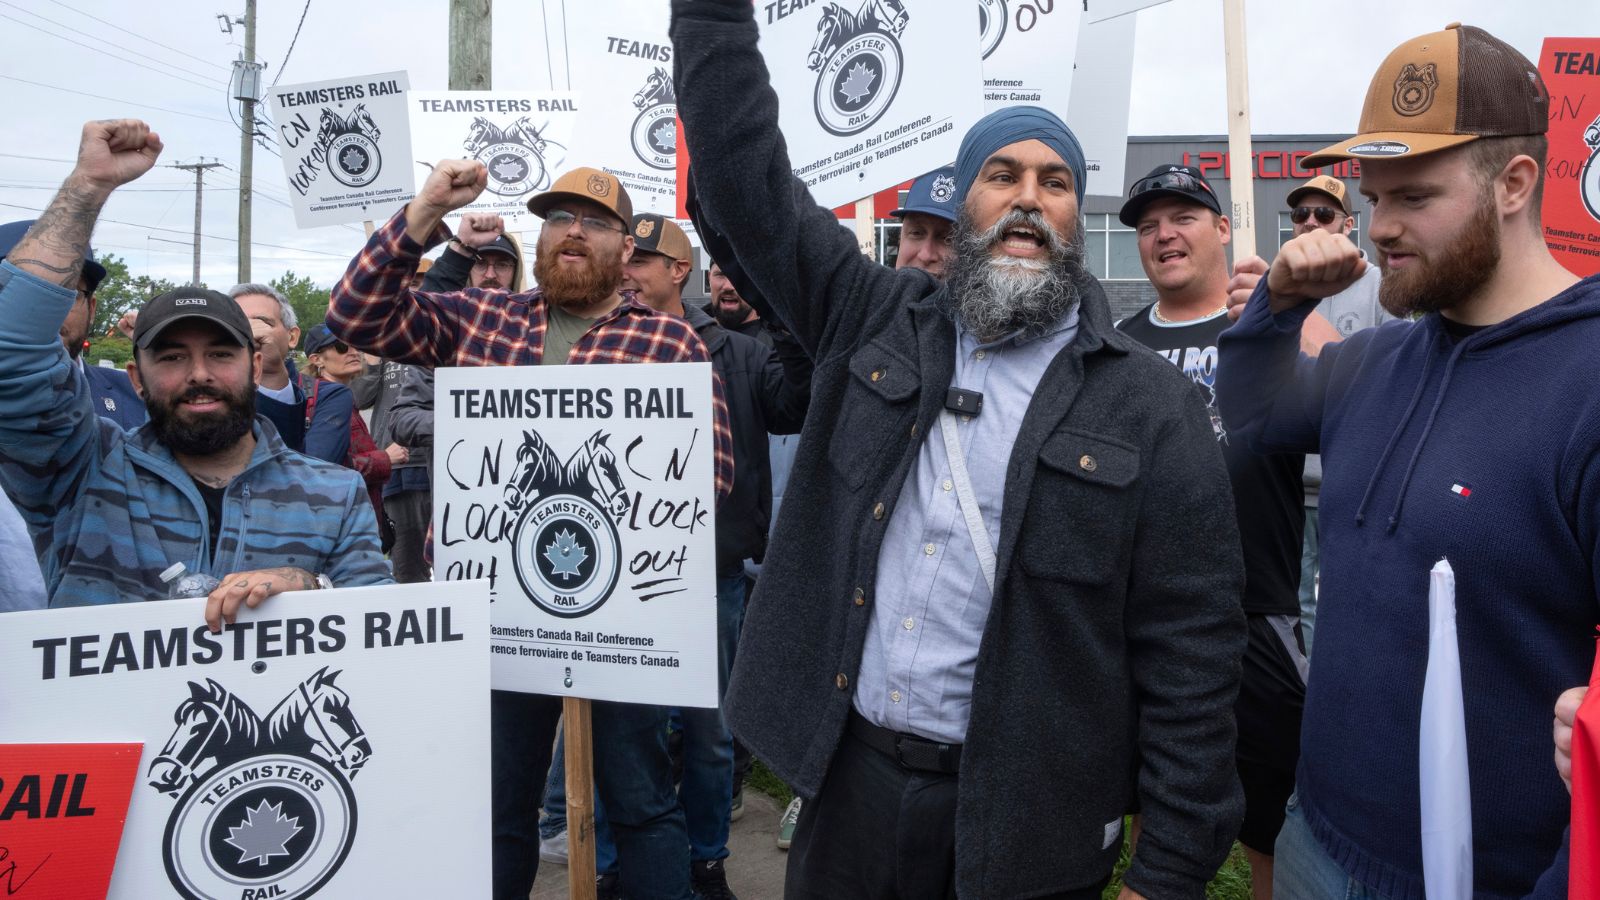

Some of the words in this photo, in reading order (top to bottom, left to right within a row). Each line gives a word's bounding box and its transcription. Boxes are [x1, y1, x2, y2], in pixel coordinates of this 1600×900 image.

[607, 37, 671, 62] TEAMS
[829, 39, 886, 74] TEAMSTERS
[277, 84, 365, 107] TEAMSTERS
[368, 80, 402, 97] RAIL
[1010, 92, 1041, 101] Canada
[419, 99, 531, 112] TEAMSTERS
[538, 99, 578, 112] RAIL
[281, 113, 311, 148] CN
[848, 113, 870, 127] RAIL
[334, 137, 368, 150] TEAMSTERS
[834, 143, 863, 161] Canada
[866, 134, 882, 148] Rail
[884, 115, 932, 141] Conference
[484, 146, 530, 158] TEAMSTERS
[654, 156, 671, 164] RAIL
[819, 159, 860, 182] ferroviaire
[863, 155, 873, 166] de
[875, 136, 918, 161] Teamsters
[921, 122, 953, 141] Canada
[602, 167, 636, 179] Teamsters
[638, 173, 662, 183] Canada
[1086, 163, 1100, 171] ada
[658, 186, 667, 195] de
[1545, 227, 1585, 240] Teamsters
[1568, 244, 1600, 257] ferrovia
[450, 388, 613, 419] TEAMSTERS
[624, 387, 693, 419] RAIL
[625, 428, 699, 482] CN
[530, 502, 601, 530] TEAMSTERS
[628, 491, 708, 534] LOCK
[553, 594, 579, 606] RAIL
[32, 614, 347, 680] TEAMSTERS
[364, 606, 464, 649] RAIL
[490, 624, 534, 638] eamsters
[537, 628, 572, 641] Canada
[575, 631, 593, 643] Rail
[596, 632, 654, 647] Conference
[491, 644, 517, 655] rence
[519, 645, 568, 659] ferroviaire
[571, 649, 583, 661] de
[586, 650, 637, 665] Teamsters
[640, 654, 680, 668] Canada
[0, 773, 96, 820] AIL
[200, 765, 325, 807] TEAMSTERS
[241, 884, 287, 900] RAIL
